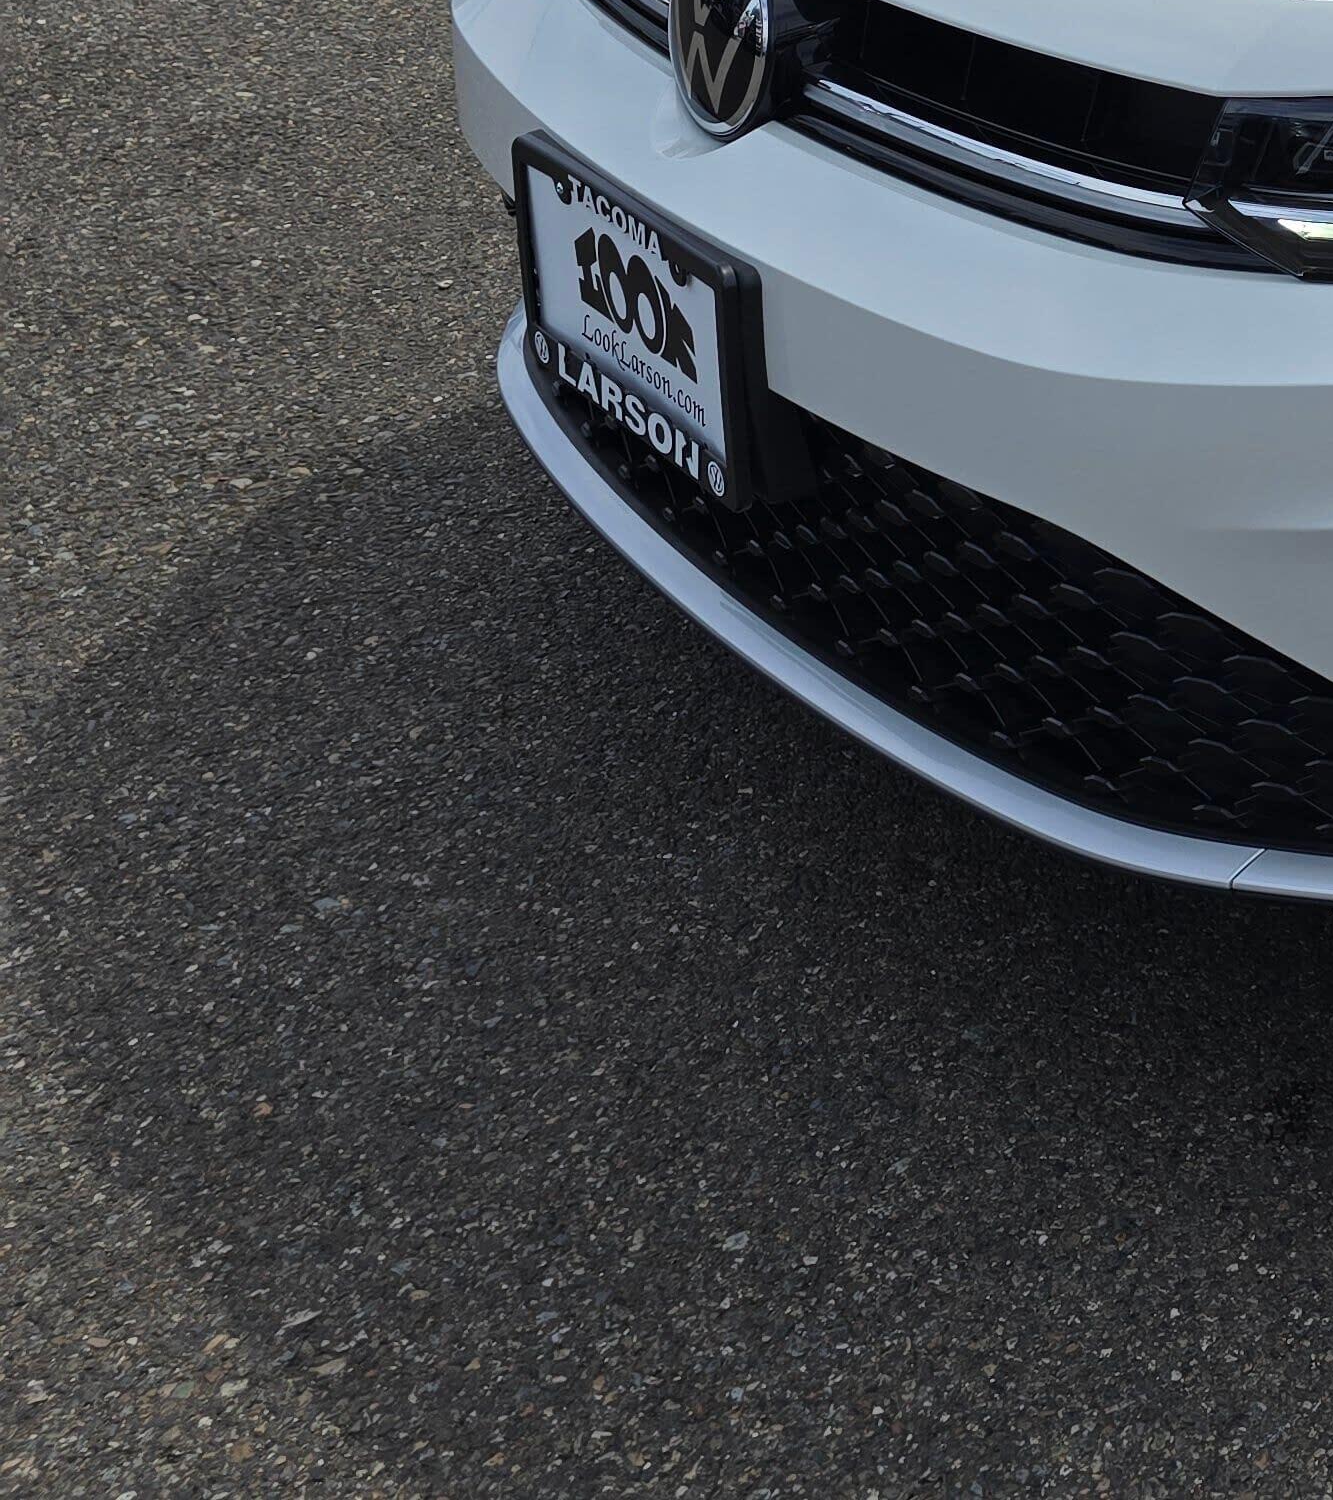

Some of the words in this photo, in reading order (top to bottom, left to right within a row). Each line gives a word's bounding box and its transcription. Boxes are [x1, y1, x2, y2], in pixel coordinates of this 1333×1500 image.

[567, 173, 665, 262] TACOMA
[574, 226, 698, 385] LOOK
[557, 342, 699, 481] LARSON
[581, 314, 707, 428] LookLarson.com
